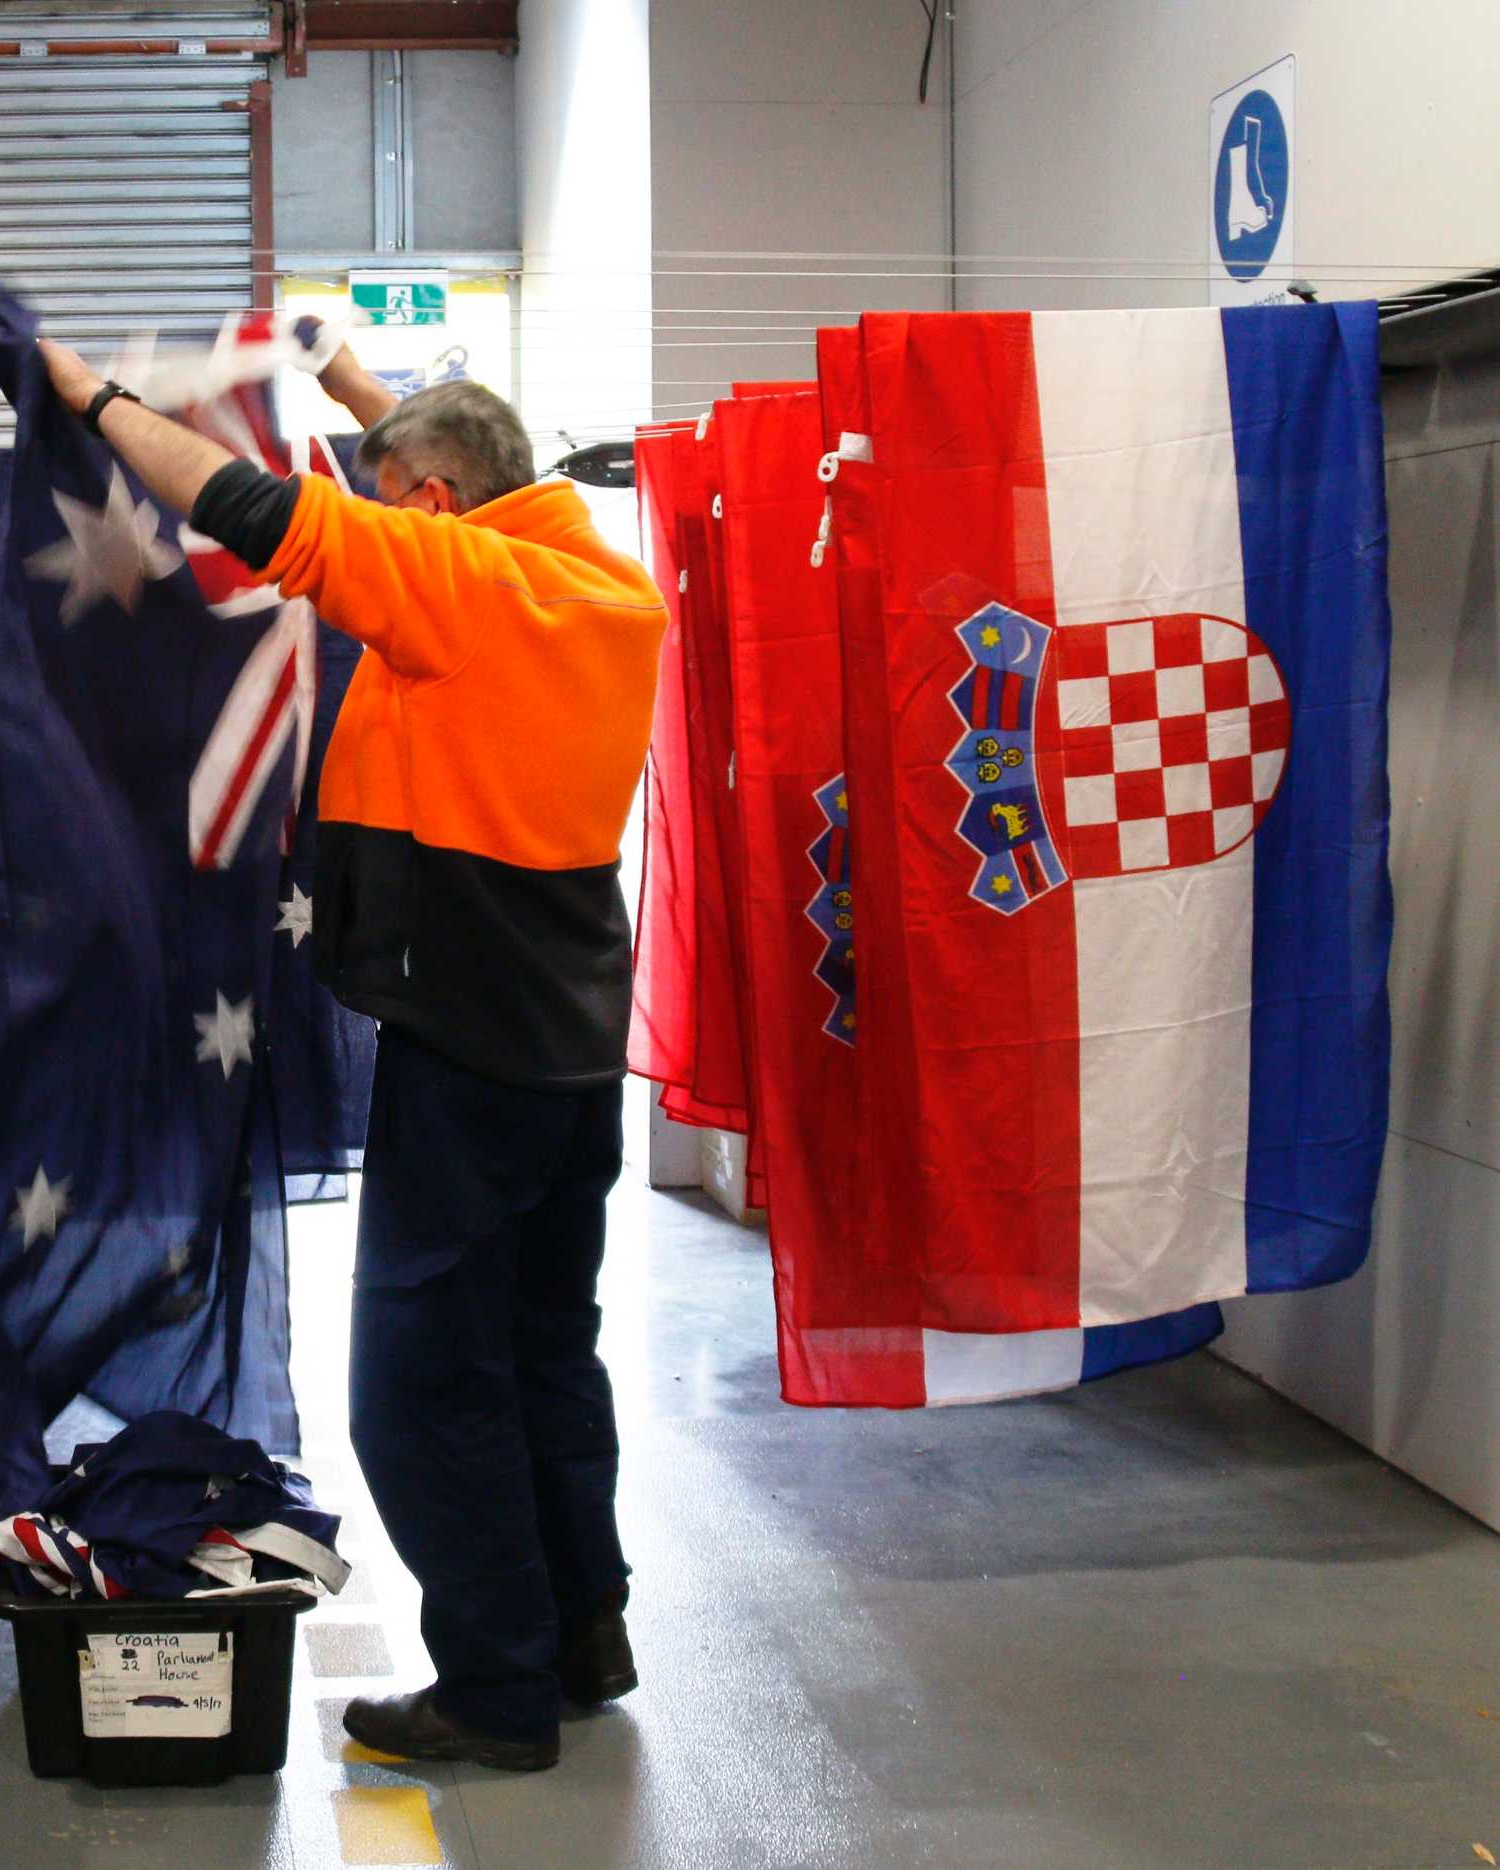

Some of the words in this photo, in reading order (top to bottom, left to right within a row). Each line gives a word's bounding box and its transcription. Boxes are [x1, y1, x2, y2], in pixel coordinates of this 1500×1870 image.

[115, 1633, 180, 1648] Croatia
[121, 1661, 141, 1671] 22
[159, 1667, 200, 1681] House
